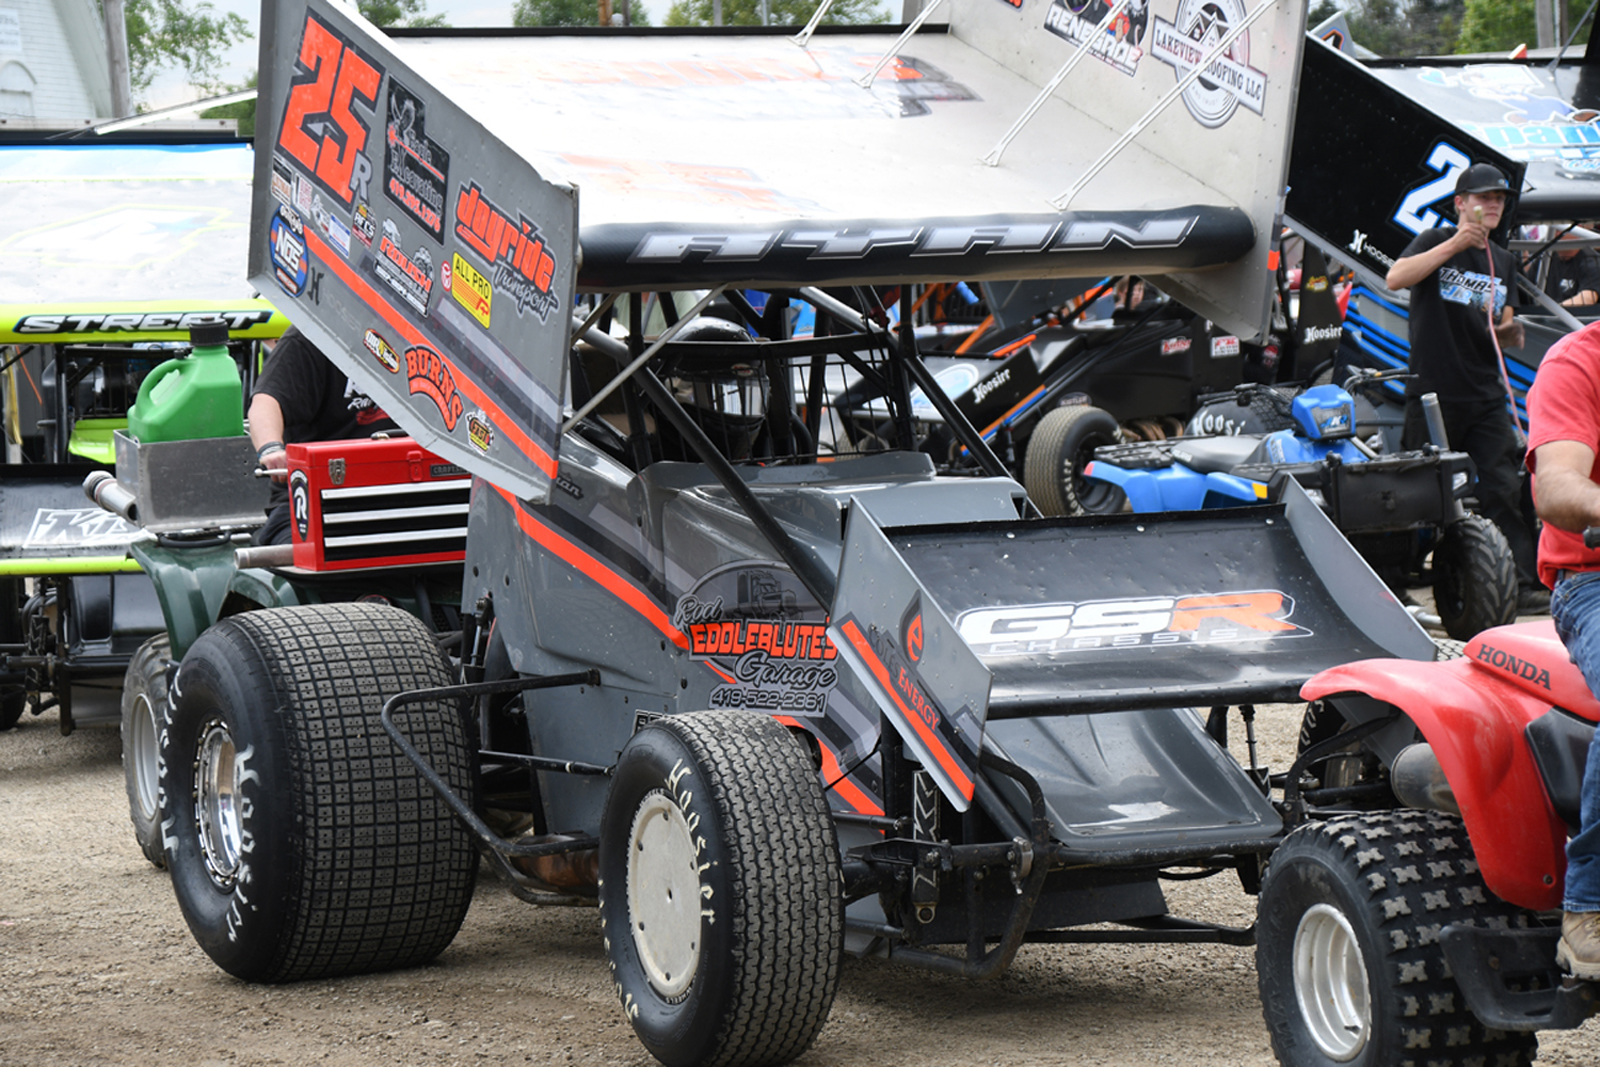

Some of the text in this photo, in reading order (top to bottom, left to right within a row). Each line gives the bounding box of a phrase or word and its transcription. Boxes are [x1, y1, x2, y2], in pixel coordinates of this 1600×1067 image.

[274, 223, 304, 276] NOS
[379, 235, 434, 294] ROUSH
[455, 257, 471, 283] ALL
[472, 272, 490, 300] PRO
[1303, 323, 1343, 345] Hoosier
[404, 348, 464, 431] BURNS
[972, 368, 1011, 404] Hoosier
[958, 591, 1298, 645] GSR
[989, 627, 1240, 655] CHASSIS
[735, 650, 839, 691] Garage
[1477, 643, 1552, 691] HONDA
[898, 666, 940, 732] ENERGY
